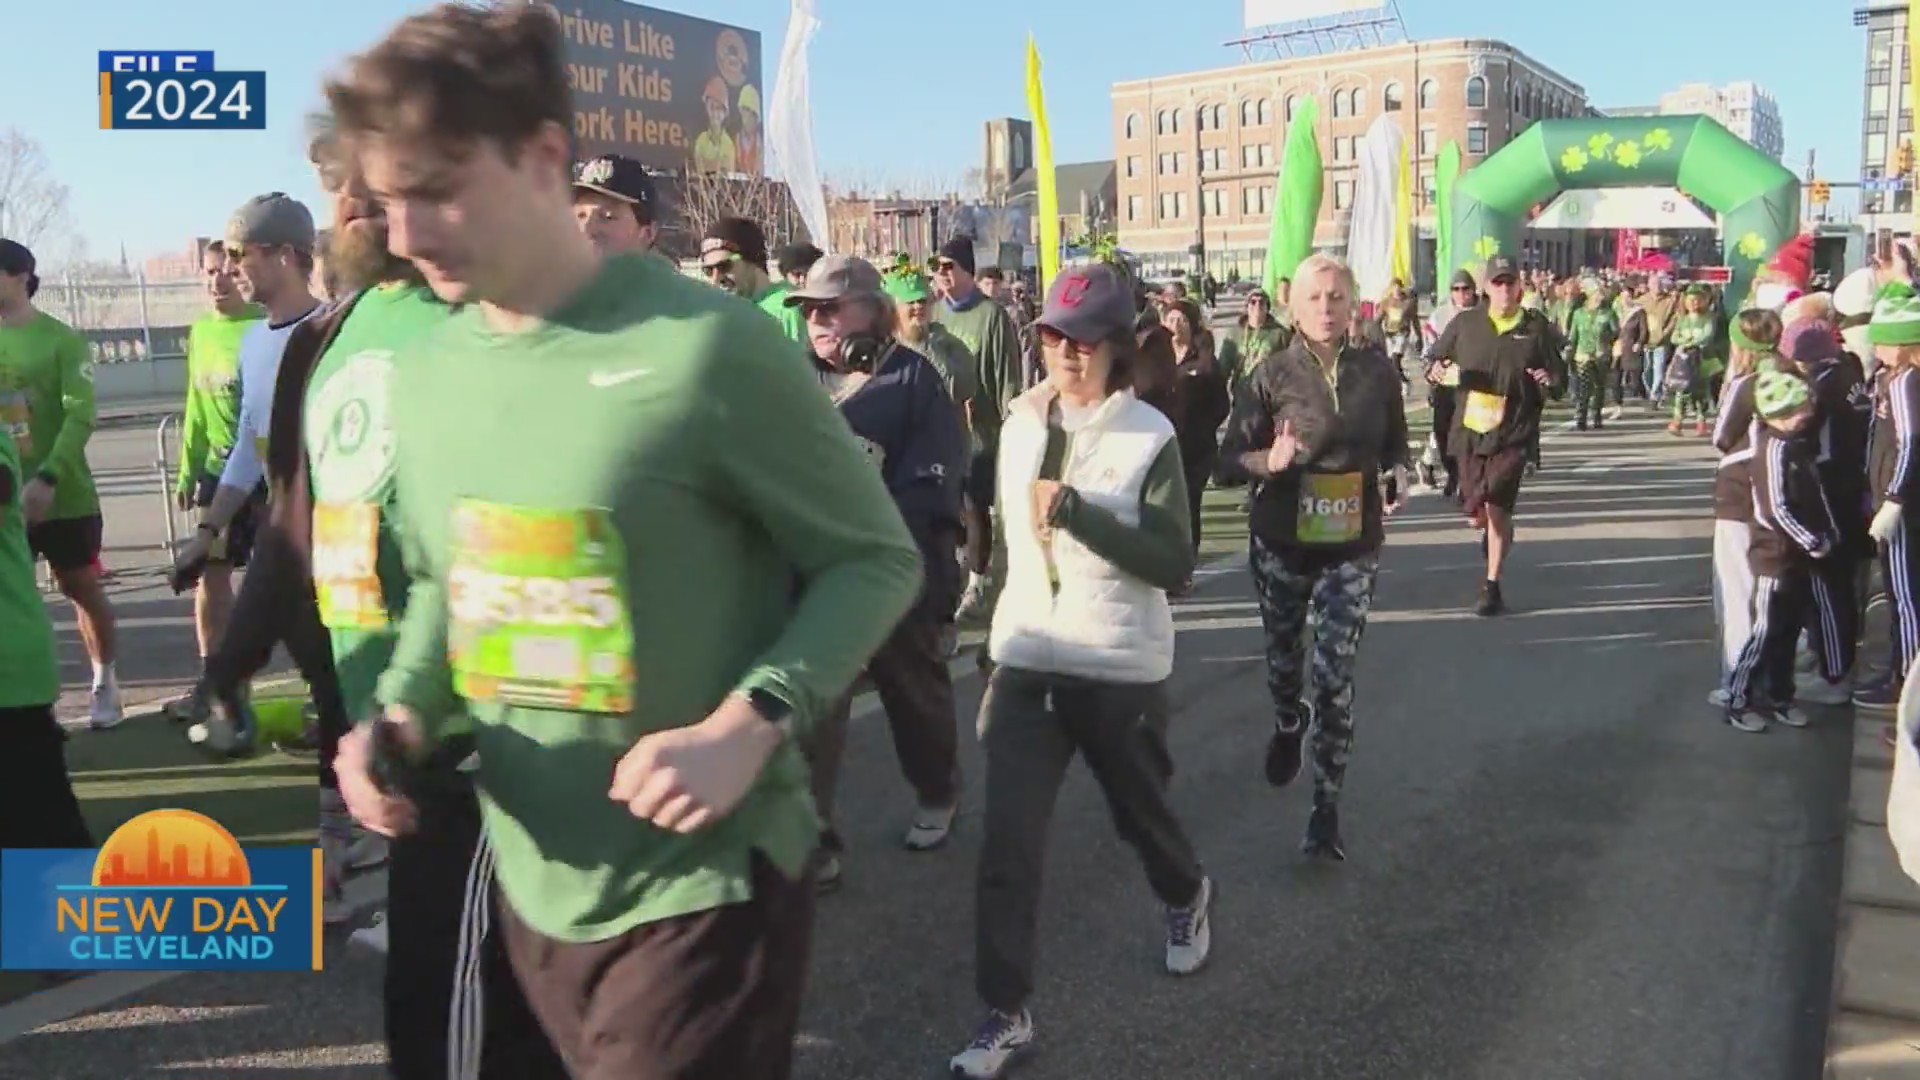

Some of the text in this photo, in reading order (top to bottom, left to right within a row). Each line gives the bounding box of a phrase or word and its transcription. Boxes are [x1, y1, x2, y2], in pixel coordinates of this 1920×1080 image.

[623, 19, 675, 60] Like
[567, 62, 672, 102] our Kids
[574, 106, 690, 148] ork Here.
[1302, 496, 1361, 515] 1603
